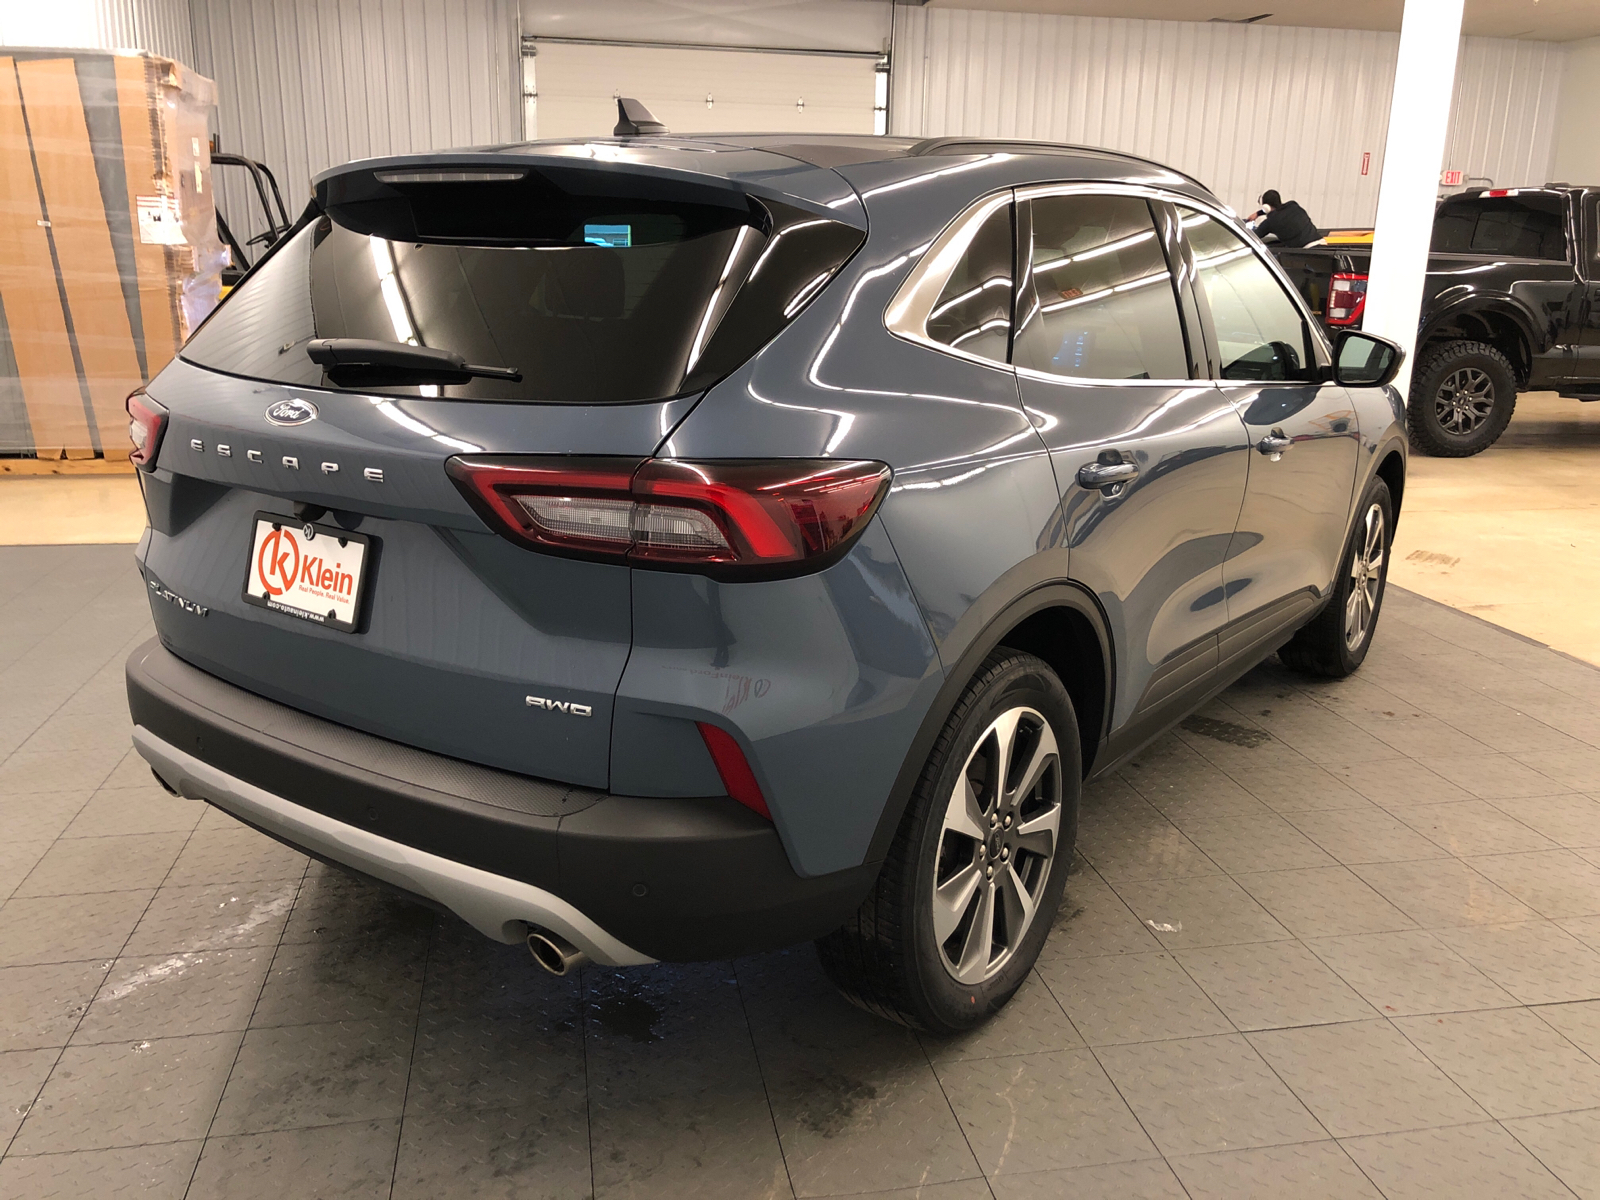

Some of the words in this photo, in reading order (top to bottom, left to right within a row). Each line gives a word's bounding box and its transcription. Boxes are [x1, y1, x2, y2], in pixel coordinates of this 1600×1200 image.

[1445, 171, 1461, 184] EXIT
[273, 403, 304, 419] Ford
[191, 439, 384, 483] ESCAPE
[300, 554, 353, 595] Klein
[149, 580, 209, 618] PLATINUM
[309, 587, 324, 598] People.
[326, 592, 336, 600] Real
[267, 601, 325, 622] www.kleinauto.com
[525, 695, 592, 717] AWD
